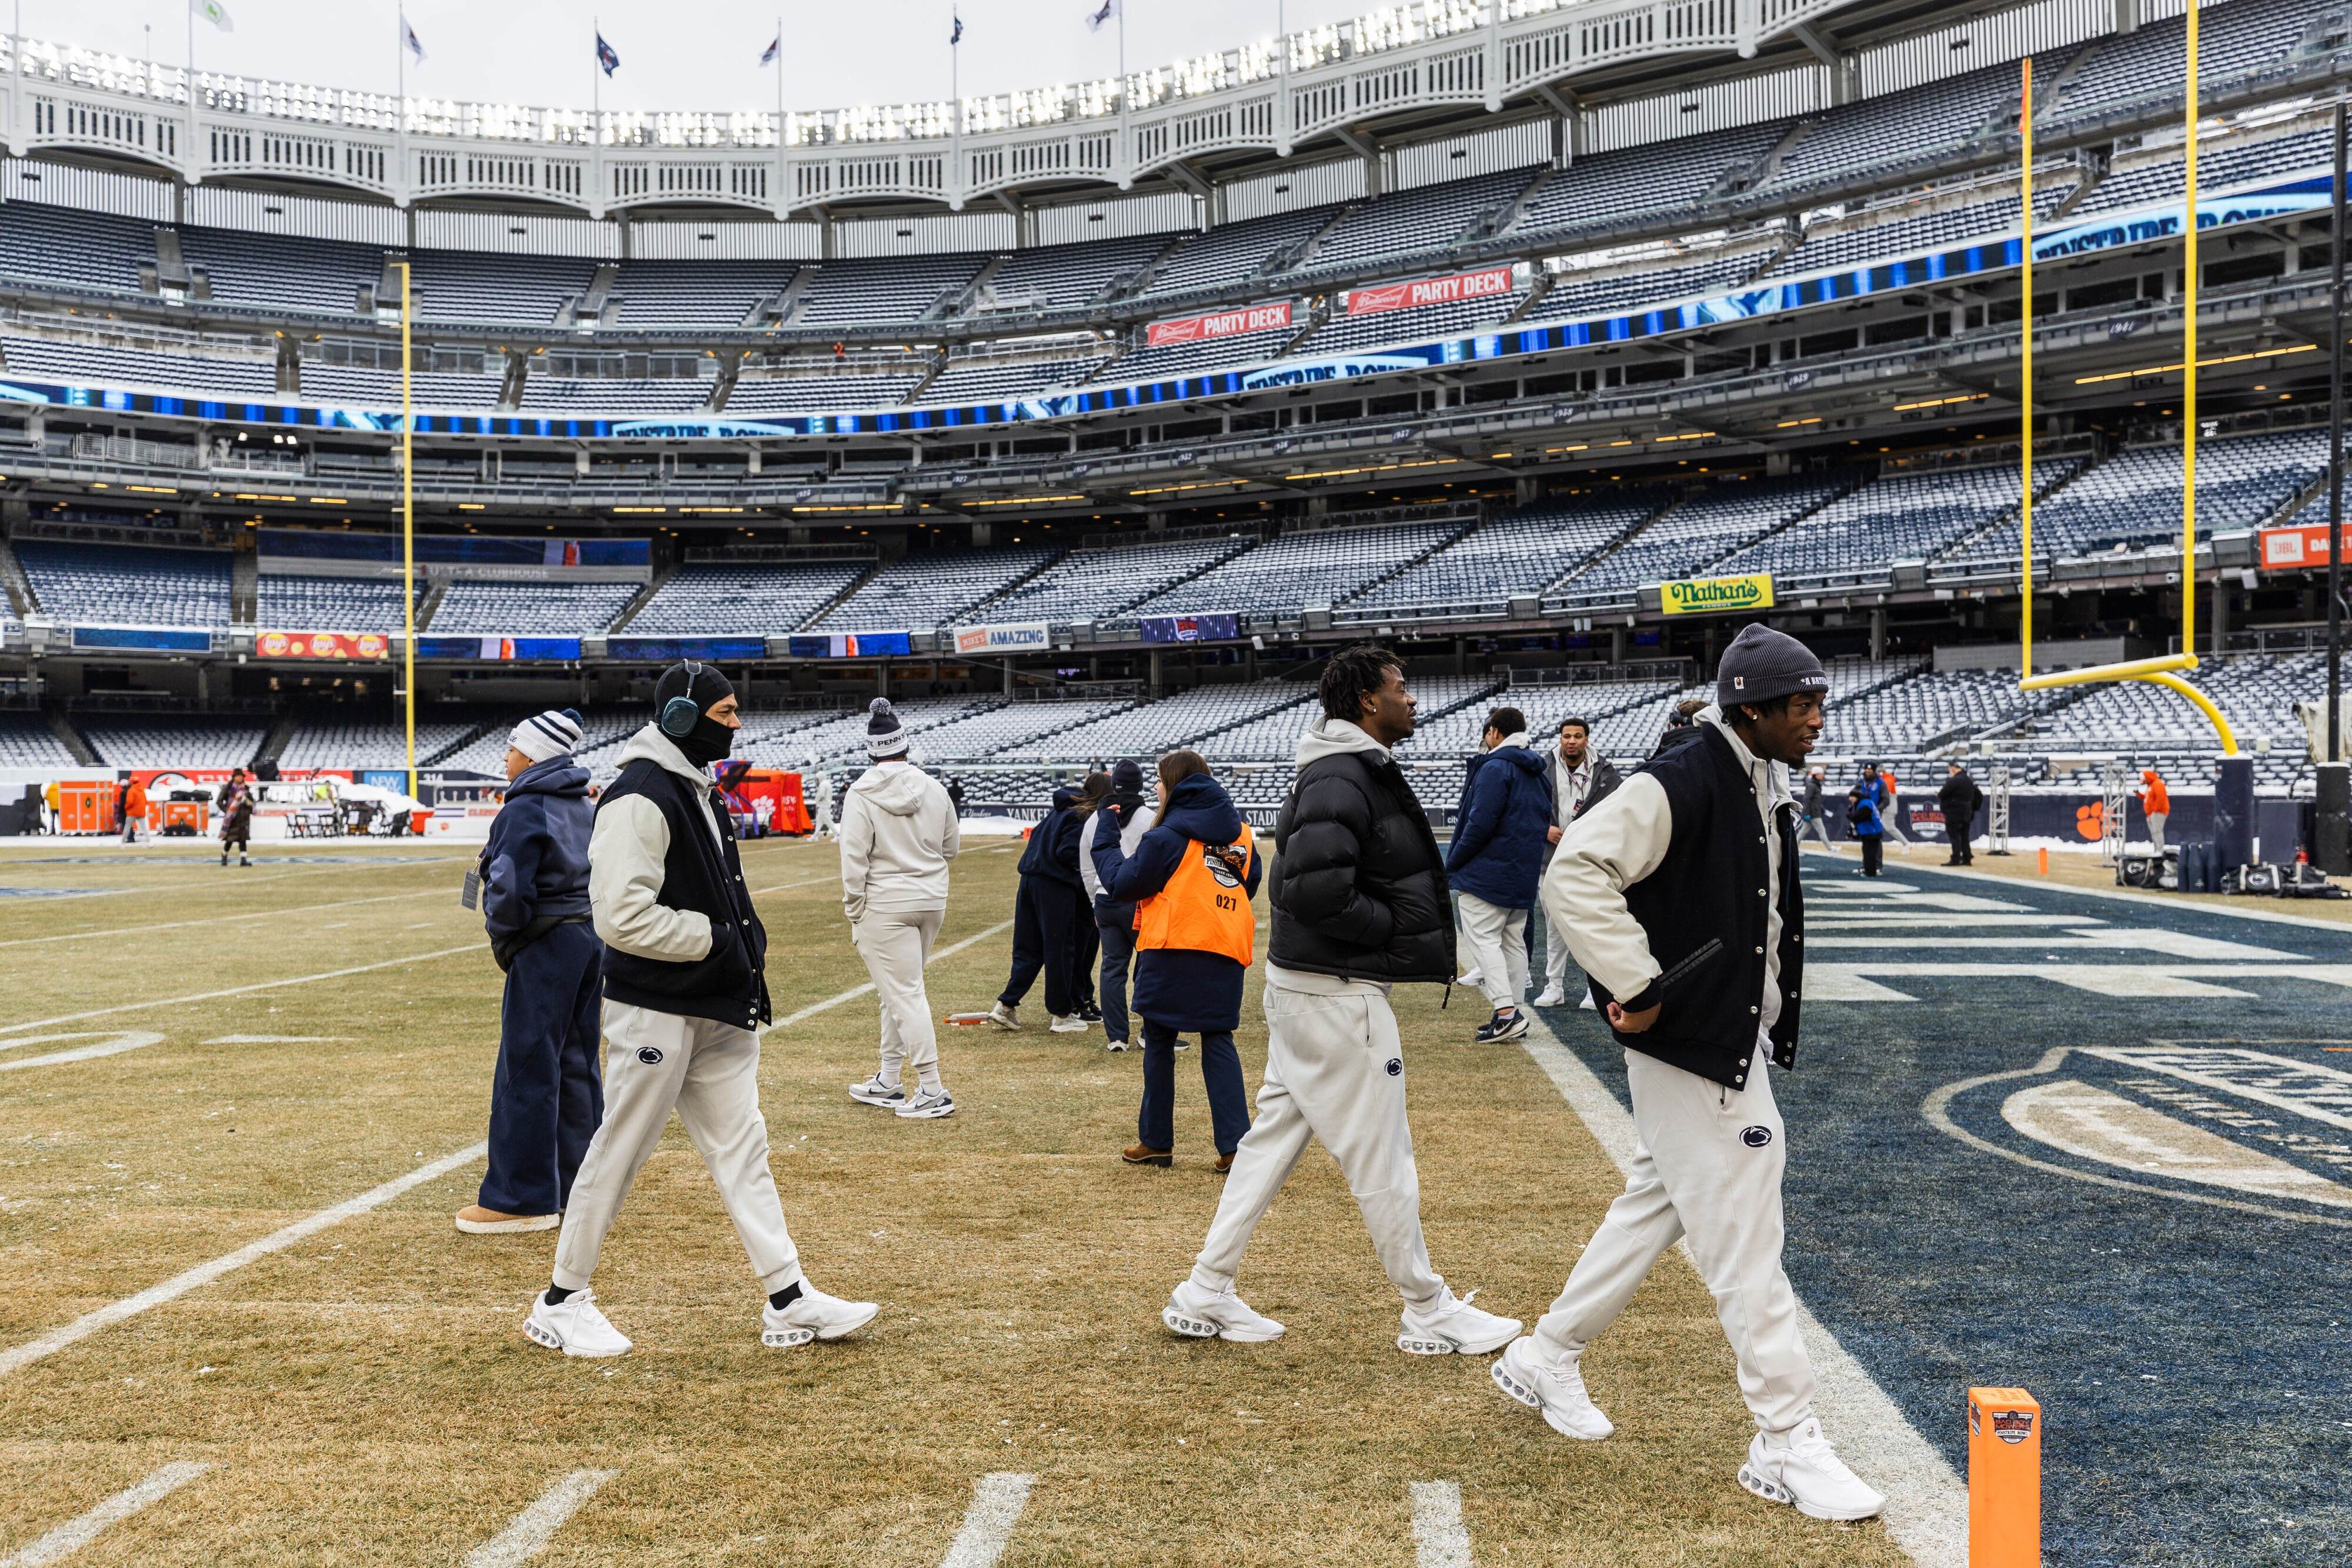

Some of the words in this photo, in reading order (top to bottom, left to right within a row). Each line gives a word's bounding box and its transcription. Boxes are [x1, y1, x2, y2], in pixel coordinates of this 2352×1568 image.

[1412, 278, 1461, 303] PARTY
[1464, 271, 1506, 295] DECK
[1204, 312, 1247, 335] PARTY
[1249, 306, 1286, 328] DECK
[2274, 541, 2296, 554] JBL
[477, 568, 548, 578] CLUBHOUSE
[1671, 579, 1758, 603] Nathan's
[963, 634, 985, 646] MIKE'S
[990, 629, 1044, 645] AMAZING
[878, 735, 901, 746] PENN
[967, 808, 991, 818] Yankees
[1246, 810, 1280, 825] STADI
[1216, 894, 1237, 911] 027
